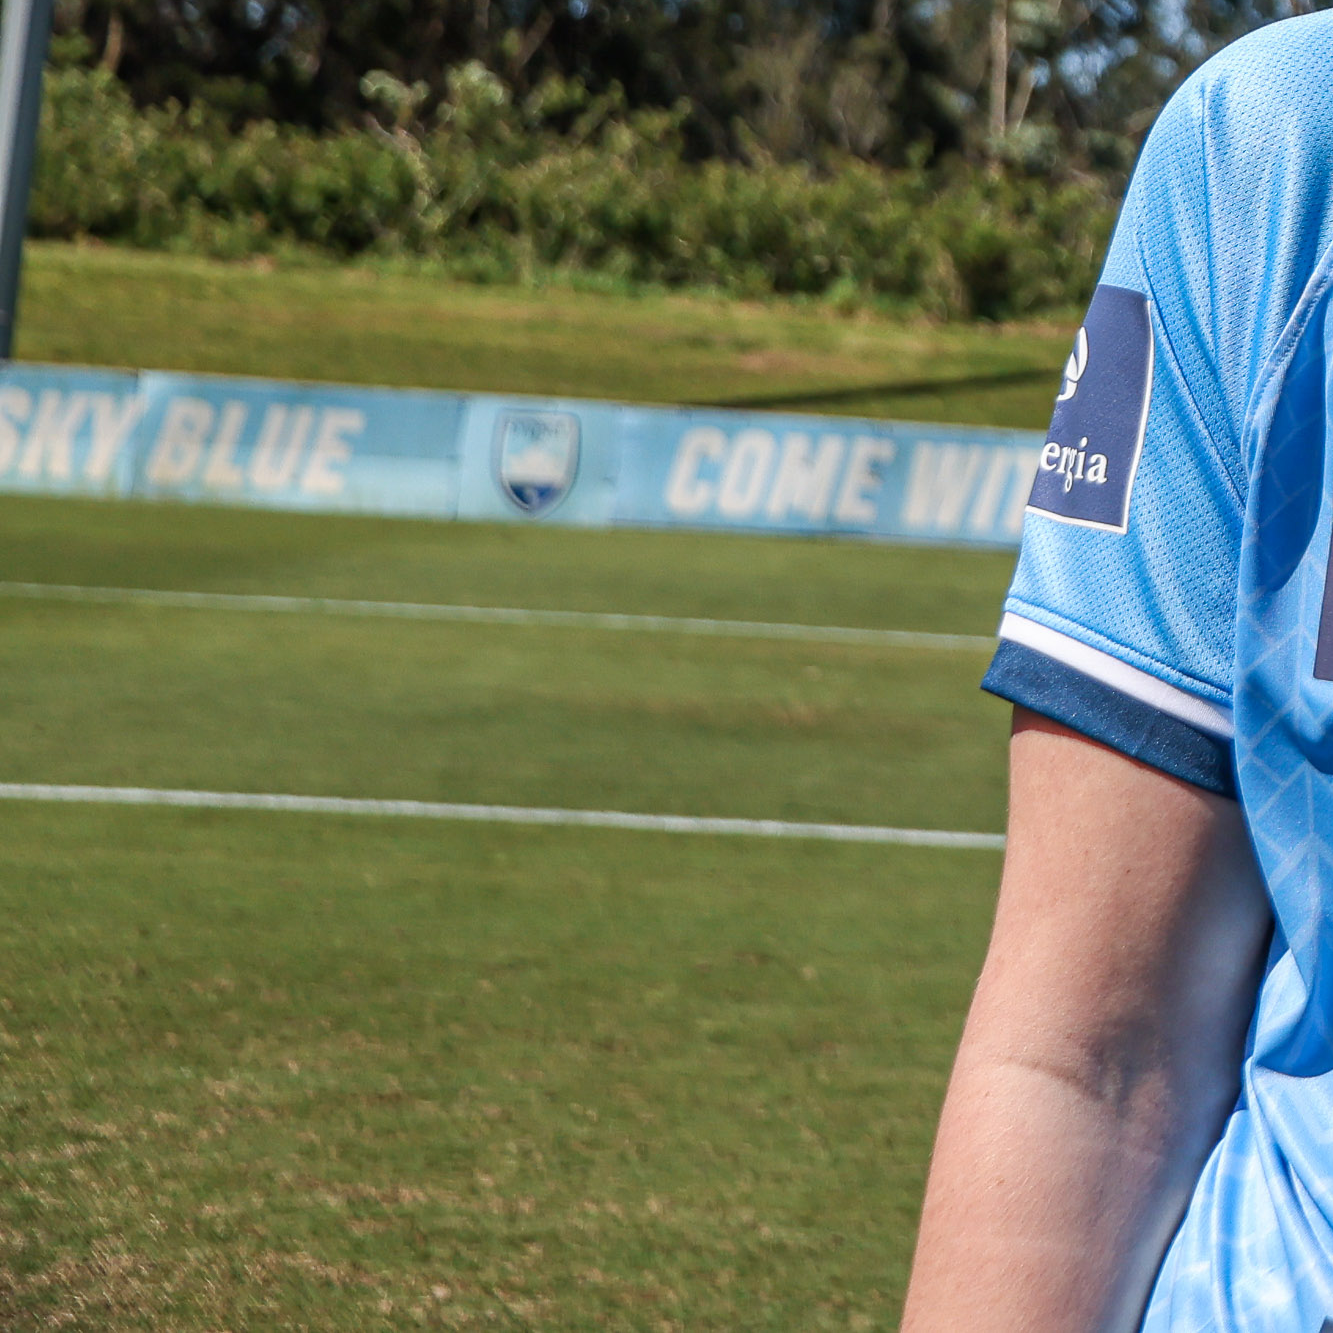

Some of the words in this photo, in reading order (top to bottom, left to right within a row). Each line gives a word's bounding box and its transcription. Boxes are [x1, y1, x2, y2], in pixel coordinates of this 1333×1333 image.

[0, 384, 148, 480] SKY
[145, 396, 367, 495] BLUE
[666, 425, 896, 525] COME
